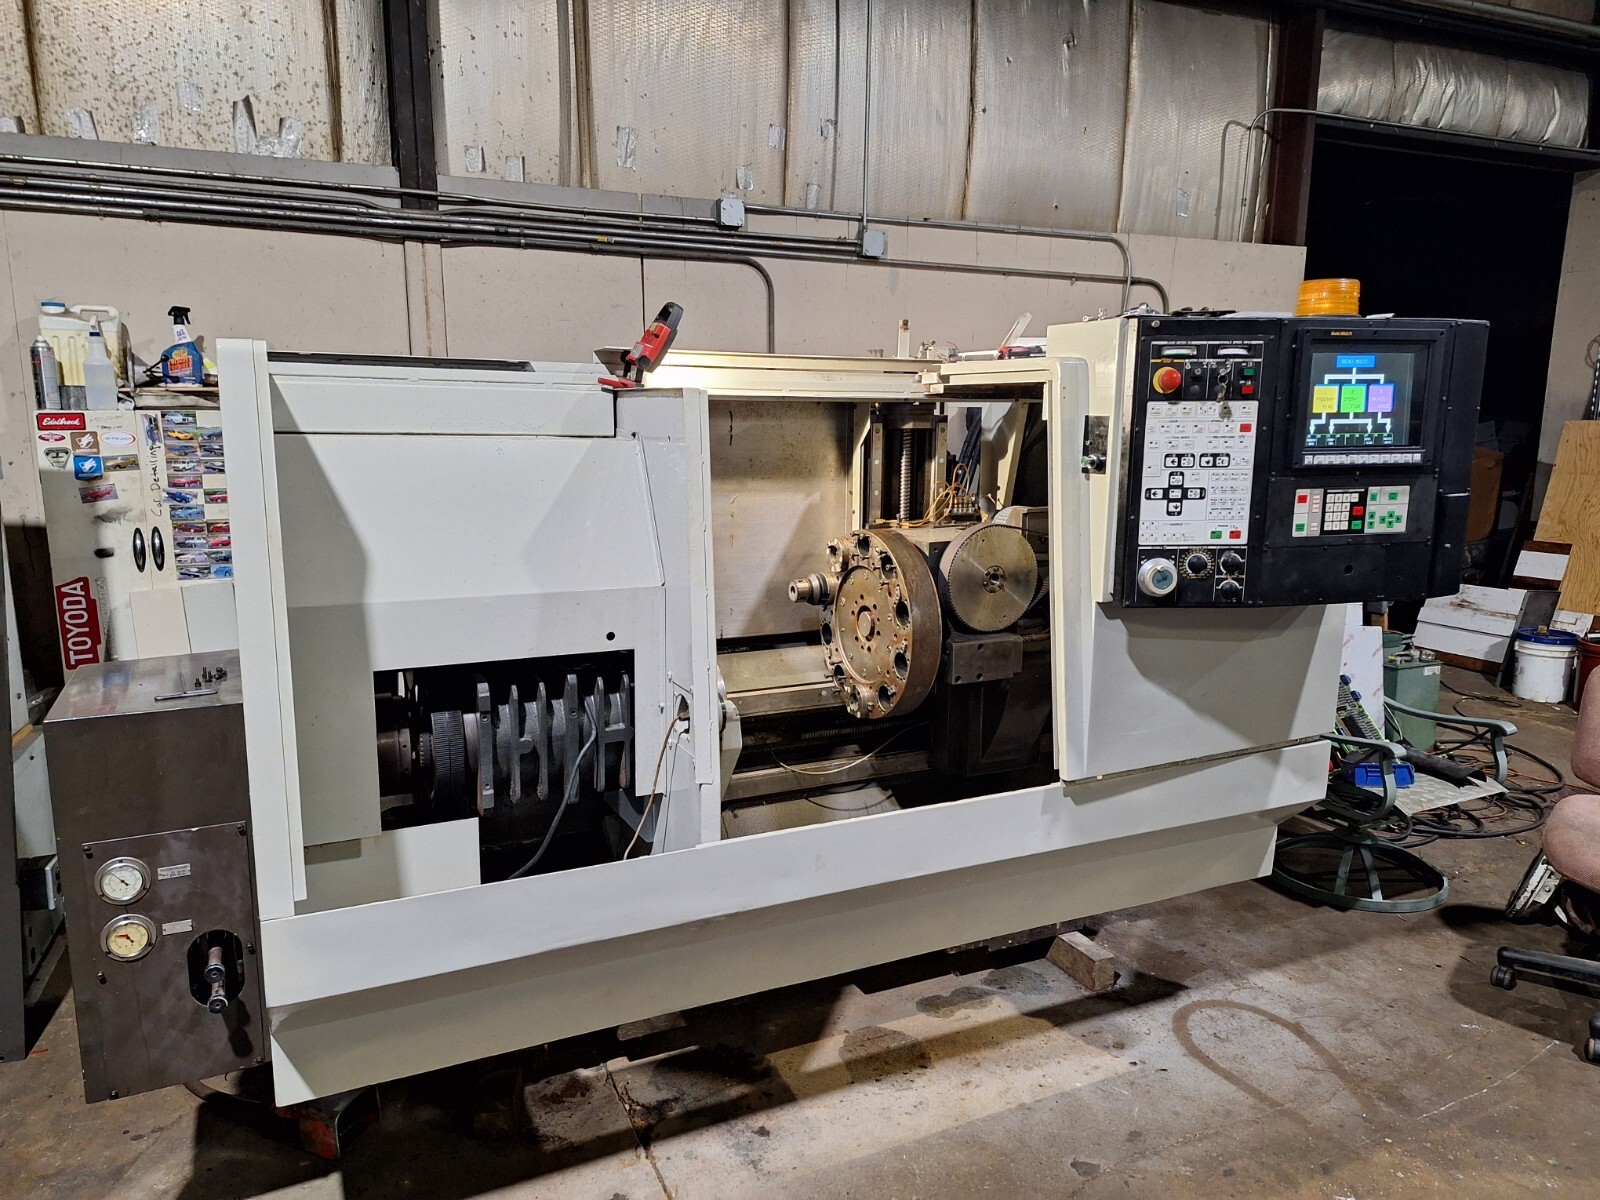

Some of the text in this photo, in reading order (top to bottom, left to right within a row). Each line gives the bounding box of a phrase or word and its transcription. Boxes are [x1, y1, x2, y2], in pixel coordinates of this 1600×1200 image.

[42, 417, 81, 426] Edelbrock
[146, 445, 161, 492] Detailing
[60, 581, 93, 665] TOYODA
